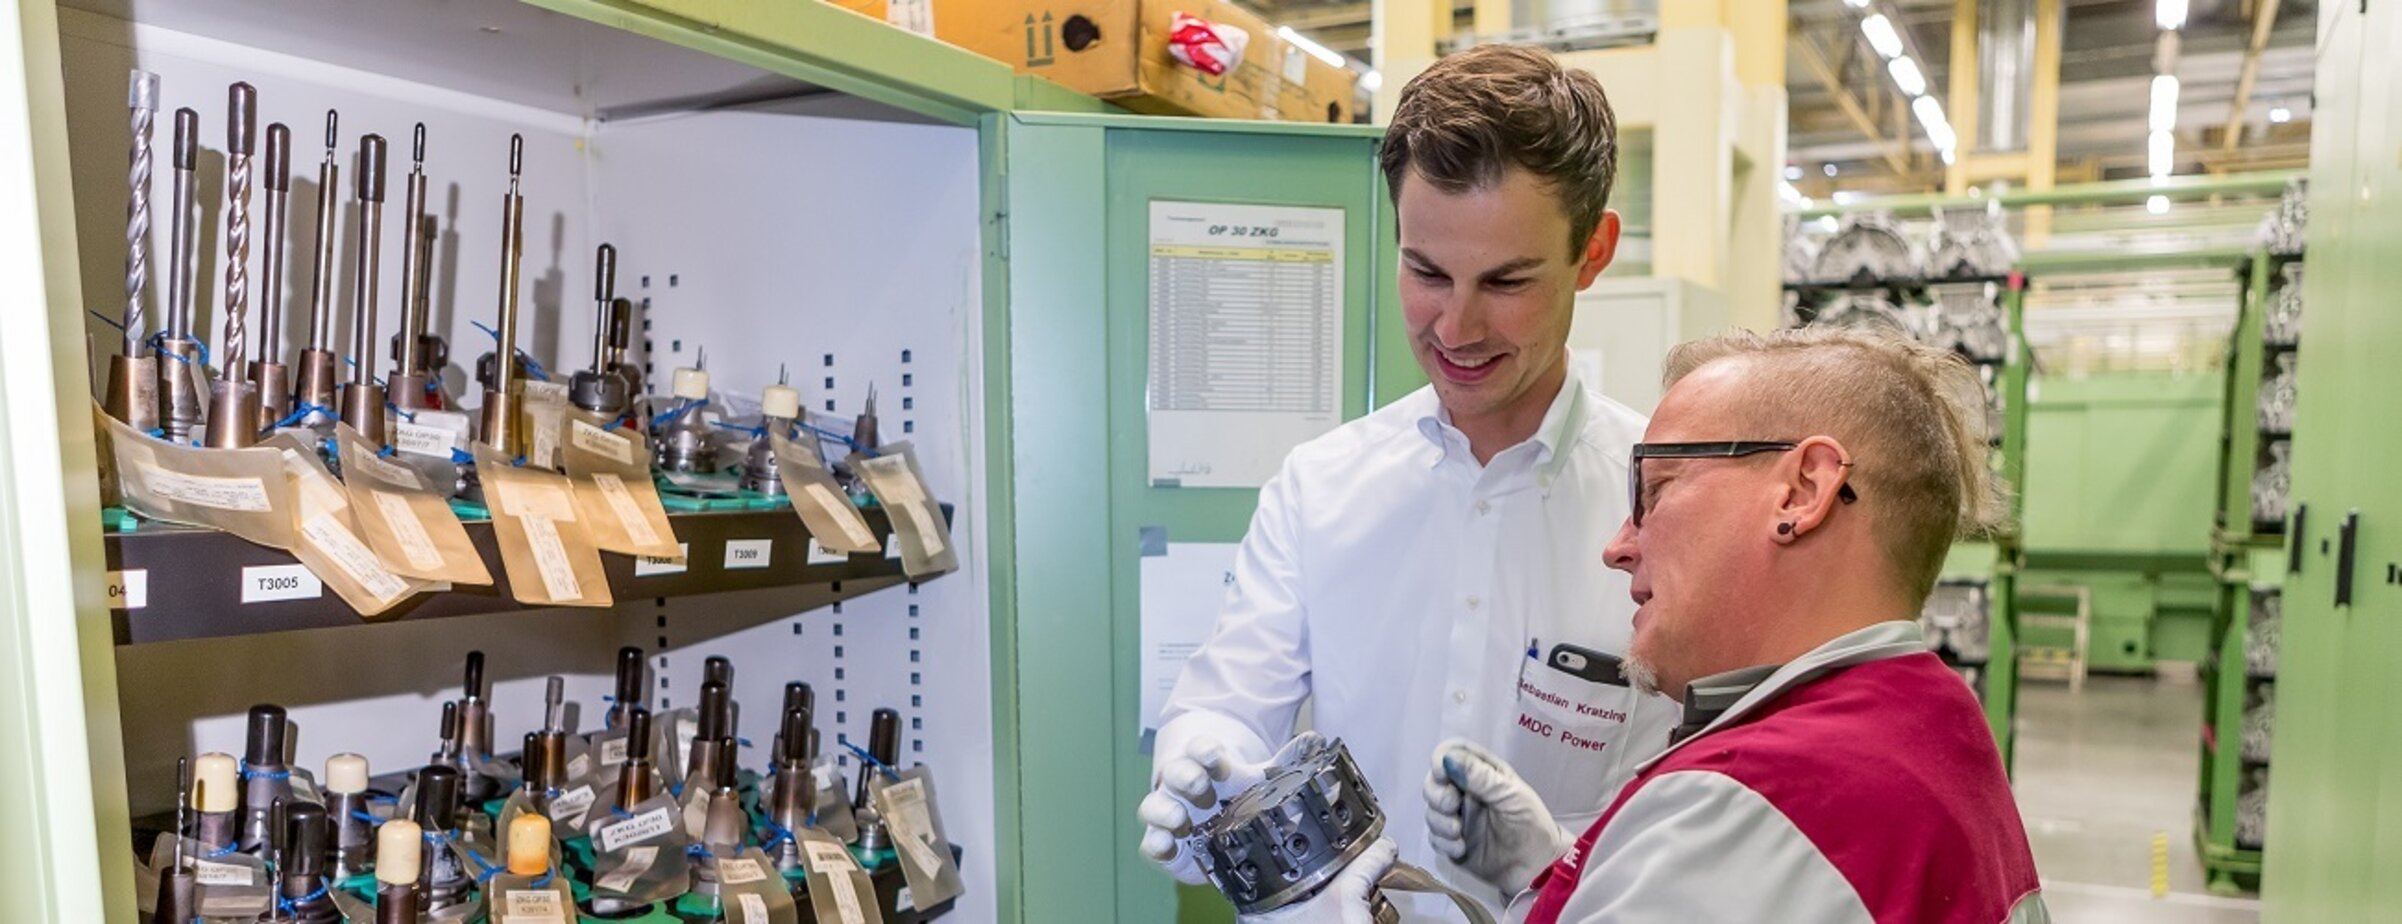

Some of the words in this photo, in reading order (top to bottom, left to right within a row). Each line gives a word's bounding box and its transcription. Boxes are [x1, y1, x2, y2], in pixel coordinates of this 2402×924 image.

[1208, 225, 1228, 236] OP
[1231, 226, 1248, 236] 30
[1249, 226, 1280, 237] ZKG
[257, 576, 299, 591] T3005
[1518, 713, 1553, 738] MDC
[1560, 731, 1607, 752] Power
